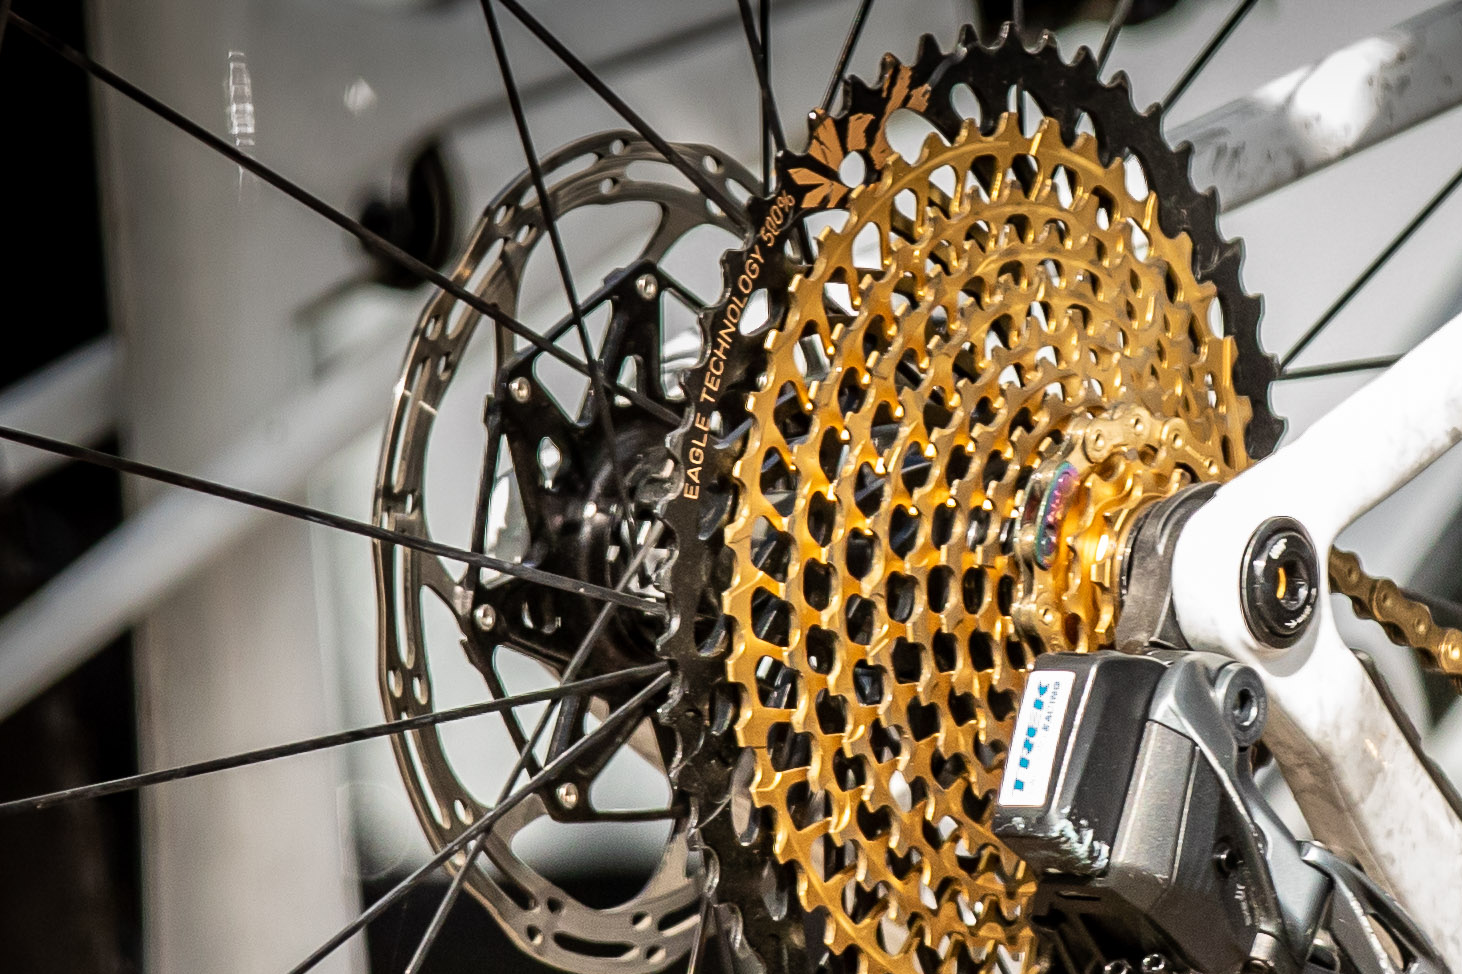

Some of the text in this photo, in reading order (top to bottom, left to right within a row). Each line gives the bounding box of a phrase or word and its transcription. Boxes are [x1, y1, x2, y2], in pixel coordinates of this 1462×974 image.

[683, 189, 796, 500] EAGLE TECHNOLOGY 500%
